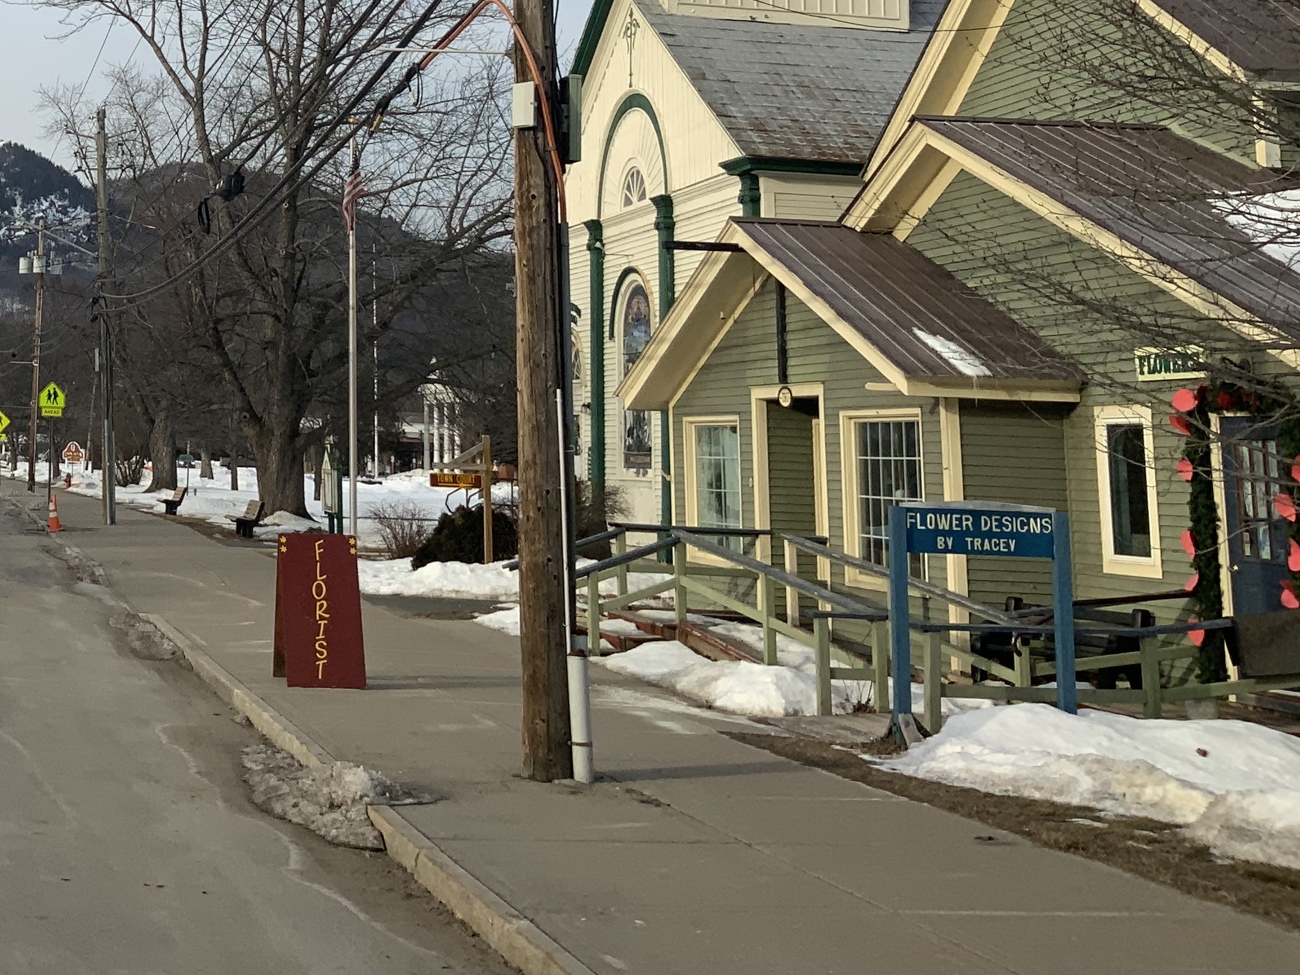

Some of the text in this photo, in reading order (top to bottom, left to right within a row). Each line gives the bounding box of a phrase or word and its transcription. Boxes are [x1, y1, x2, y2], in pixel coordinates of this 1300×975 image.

[437, 474, 475, 484] TOWN COURT
[907, 512, 1052, 534] FLOWER DESIGNS
[937, 537, 1016, 552] BY TRACEY
[312, 539, 330, 679] FLORIST
